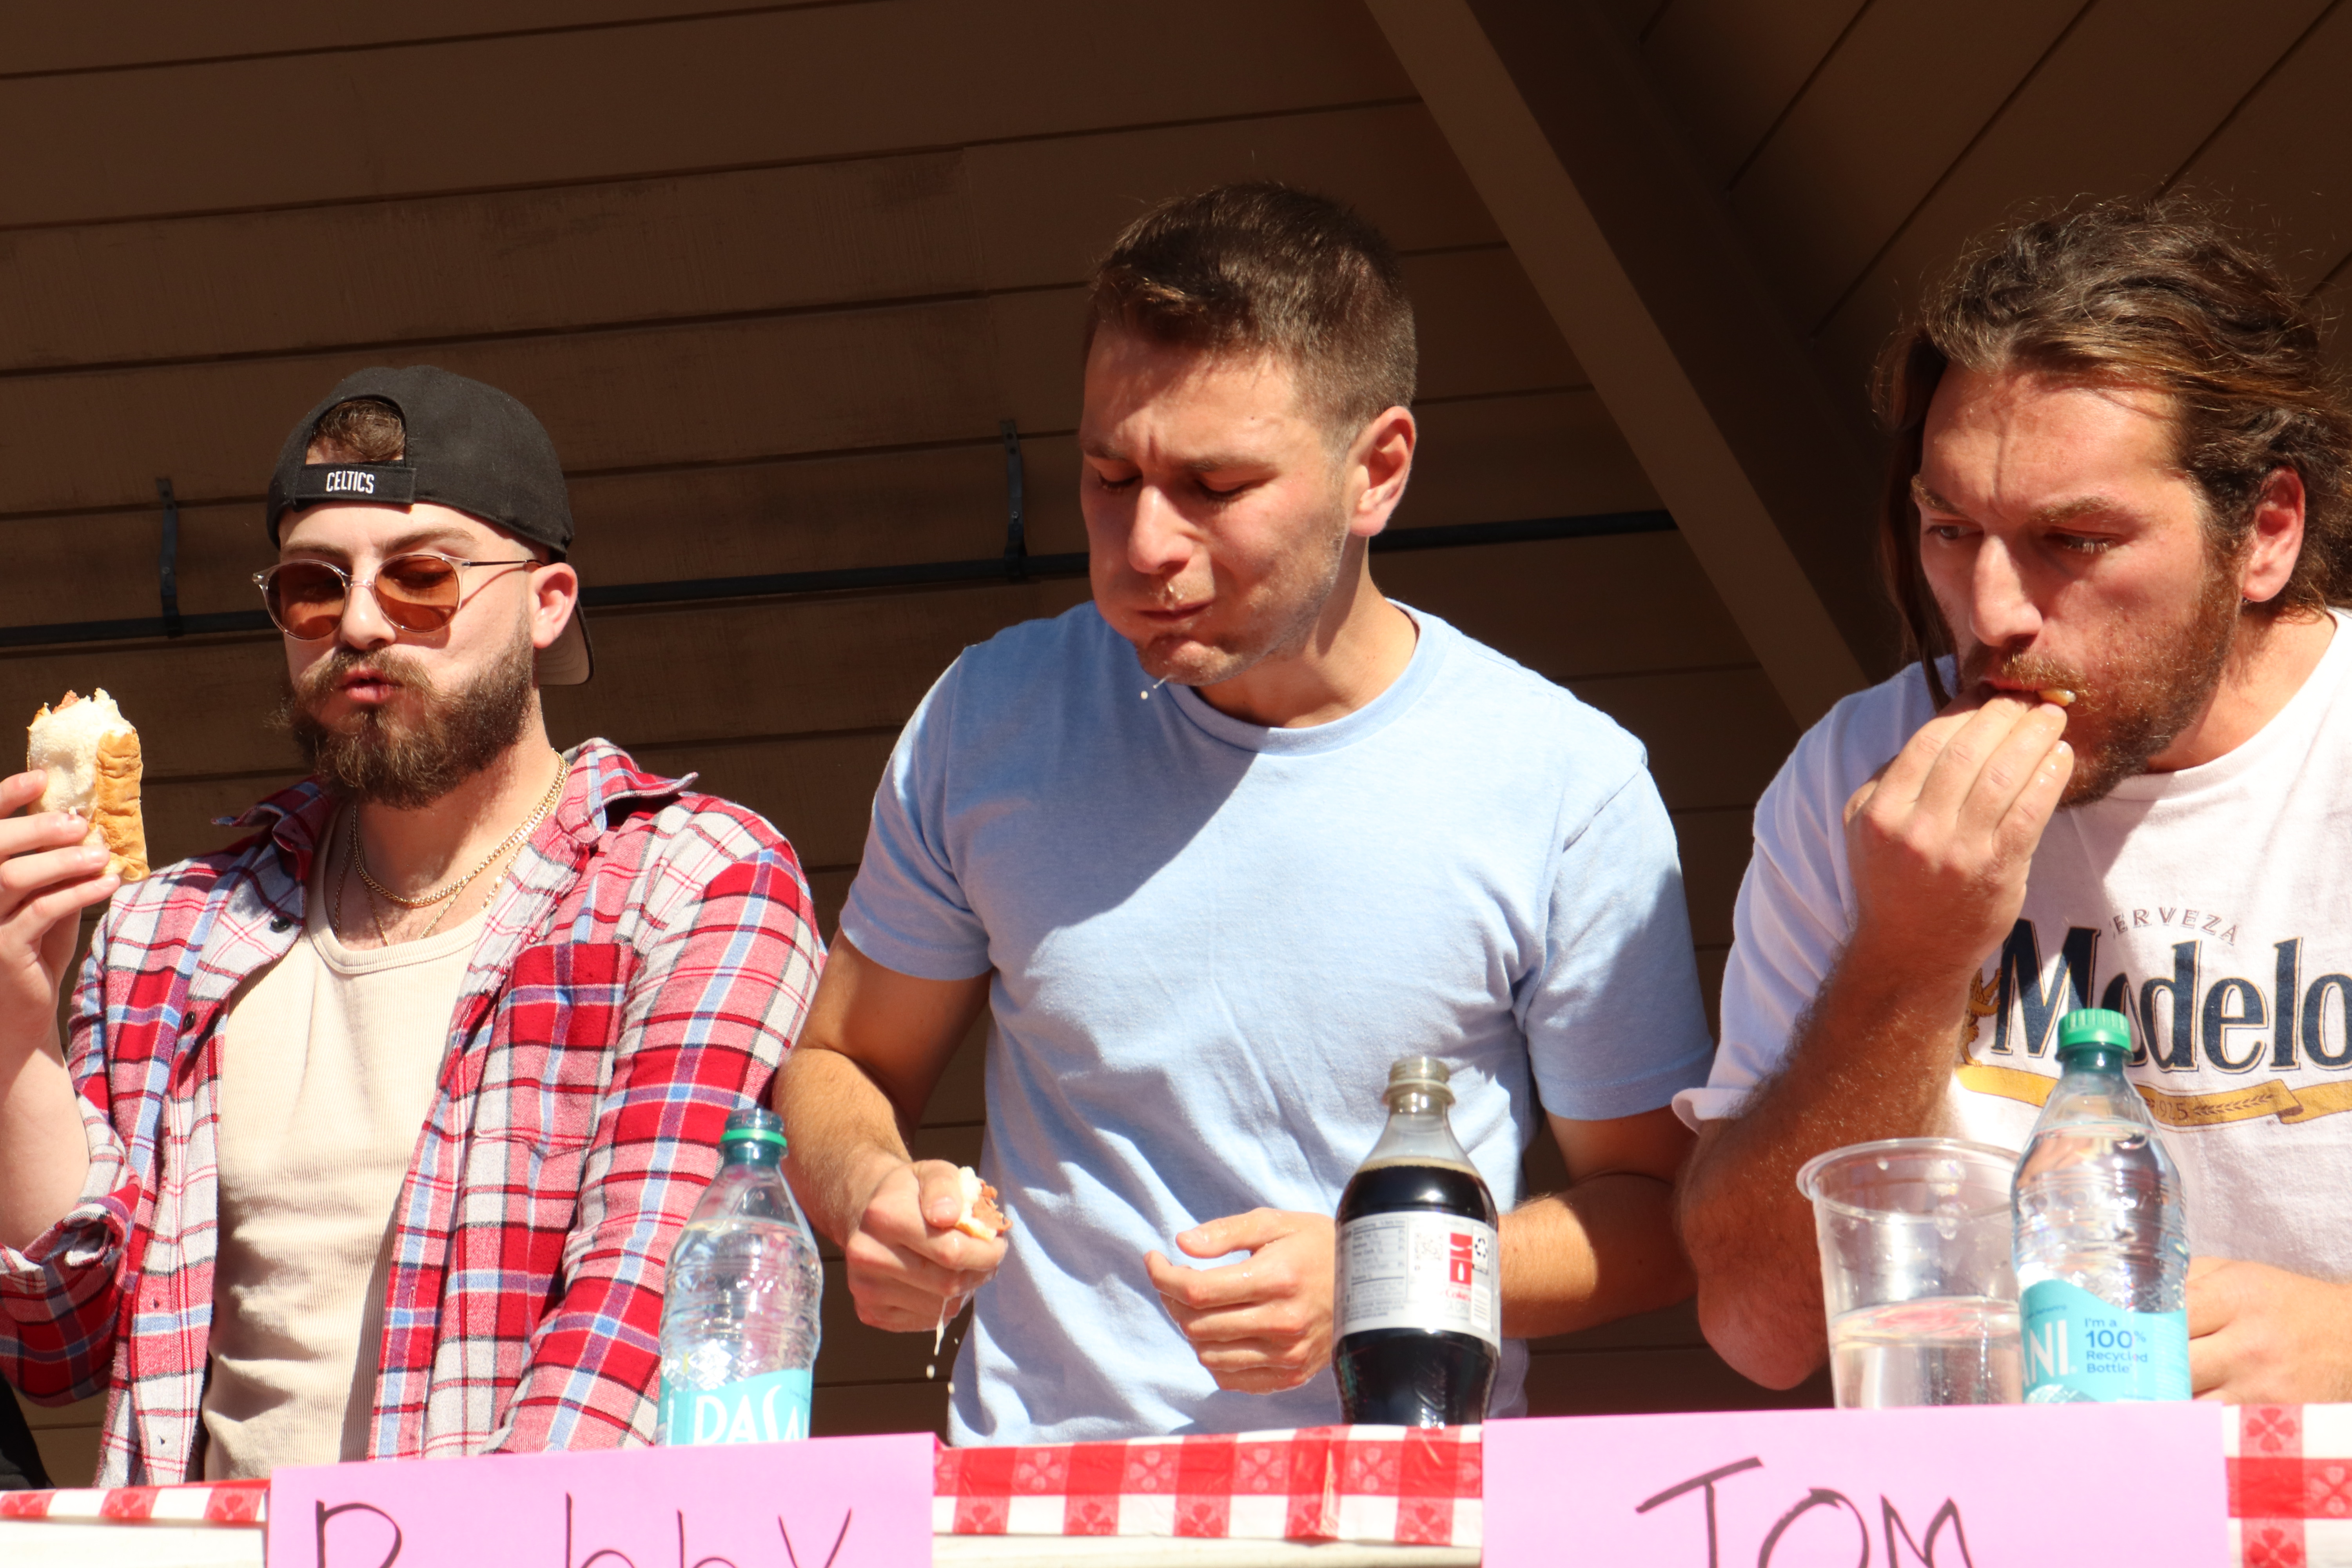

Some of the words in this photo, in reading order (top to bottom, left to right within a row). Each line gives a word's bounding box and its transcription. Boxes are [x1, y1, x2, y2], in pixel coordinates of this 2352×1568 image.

[326, 470, 375, 494] CELTICS
[2109, 907, 2239, 946] ERVEZA
[2156, 1100, 2189, 1120] 1925
[2085, 1318, 2105, 1327] I'm
[693, 1385, 809, 1446] DASA
